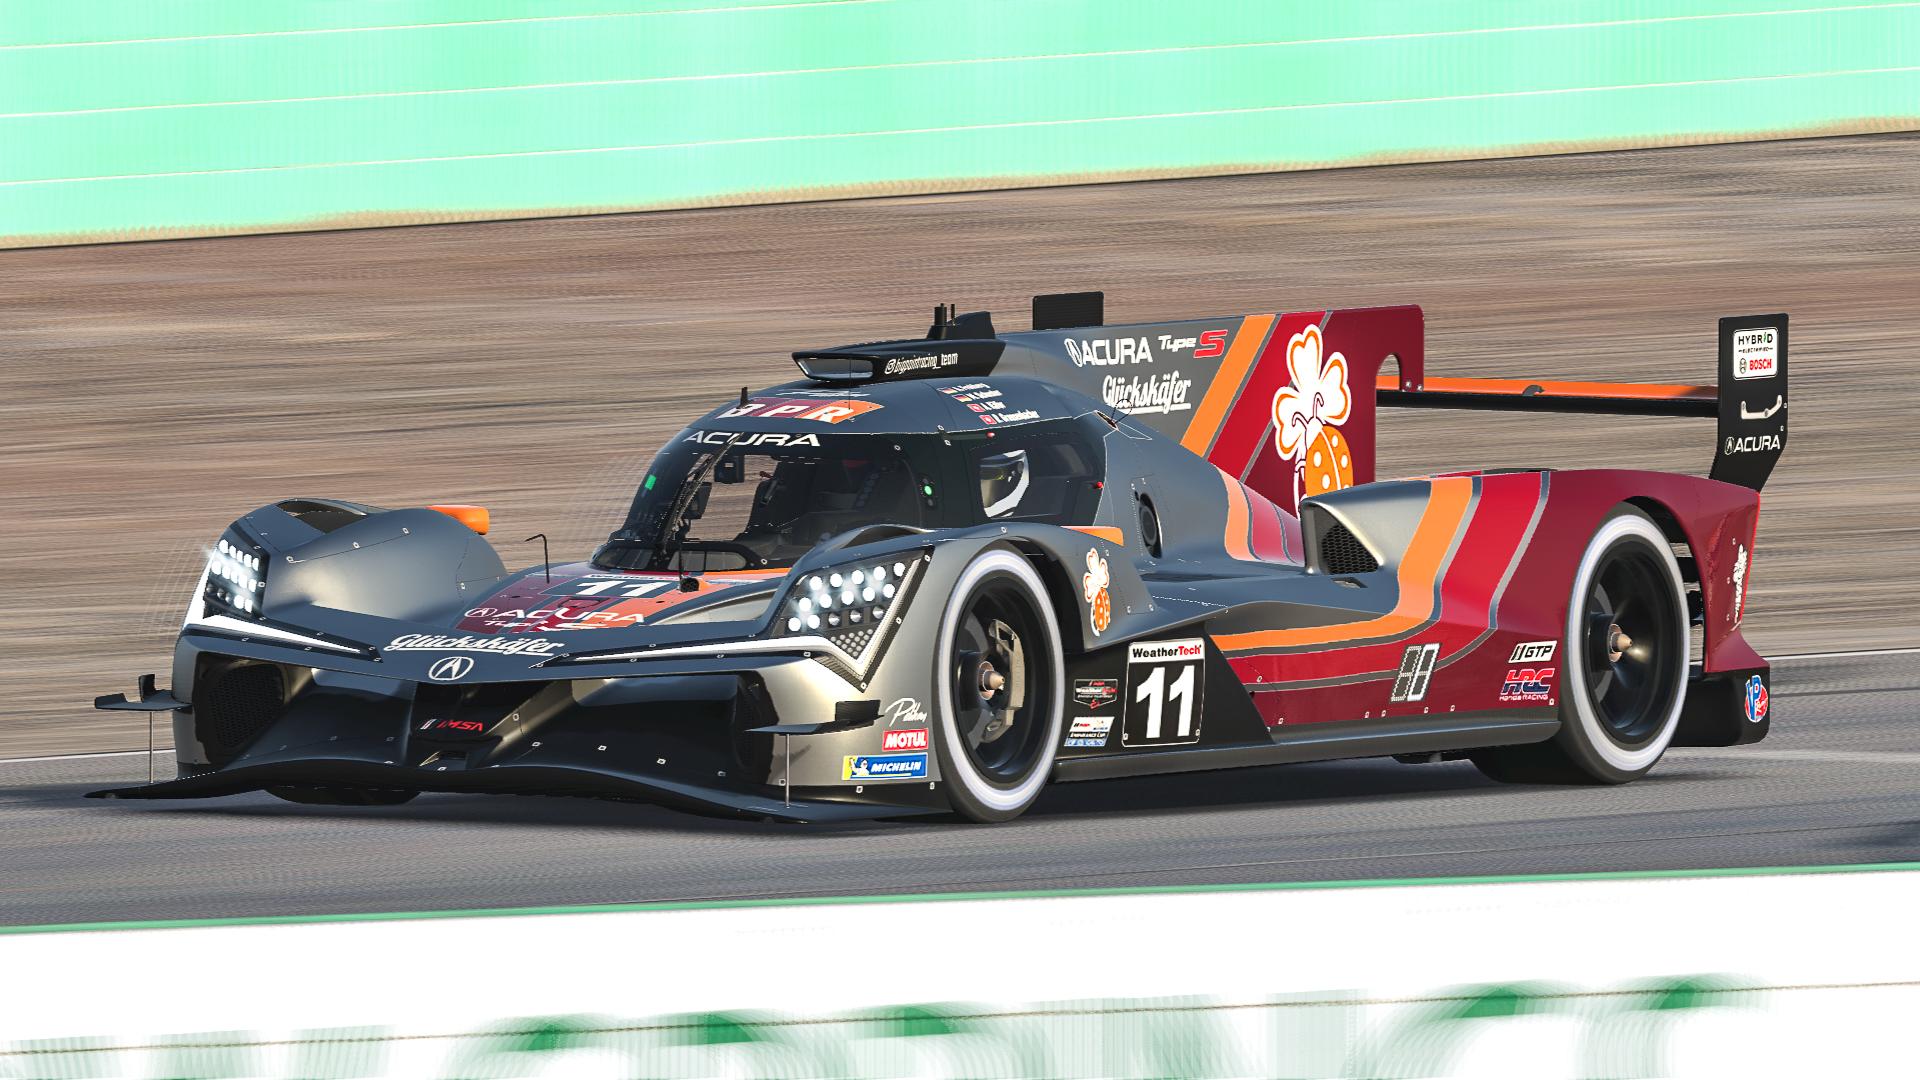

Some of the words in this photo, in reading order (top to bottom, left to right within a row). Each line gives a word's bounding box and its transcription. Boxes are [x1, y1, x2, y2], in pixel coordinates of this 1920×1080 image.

[1082, 336, 1153, 365] ACURA
[1158, 334, 1197, 352] Type
[1193, 329, 1228, 359] S
[1749, 358, 1772, 370] BOSCH
[1102, 370, 1192, 414] Glückskäfer
[683, 430, 821, 447] ACURA
[1734, 434, 1780, 453] ACURA
[575, 580, 673, 597] 11
[493, 607, 644, 623] ACURA
[384, 634, 565, 656] Glückskäfer
[1132, 644, 1201, 658] WeatherTech
[1501, 667, 1555, 695] HRC
[1136, 664, 1195, 739] 11
[1522, 693, 1549, 701] RACING
[884, 731, 927, 749] MOTUL
[870, 760, 922, 773] MICHELIN
